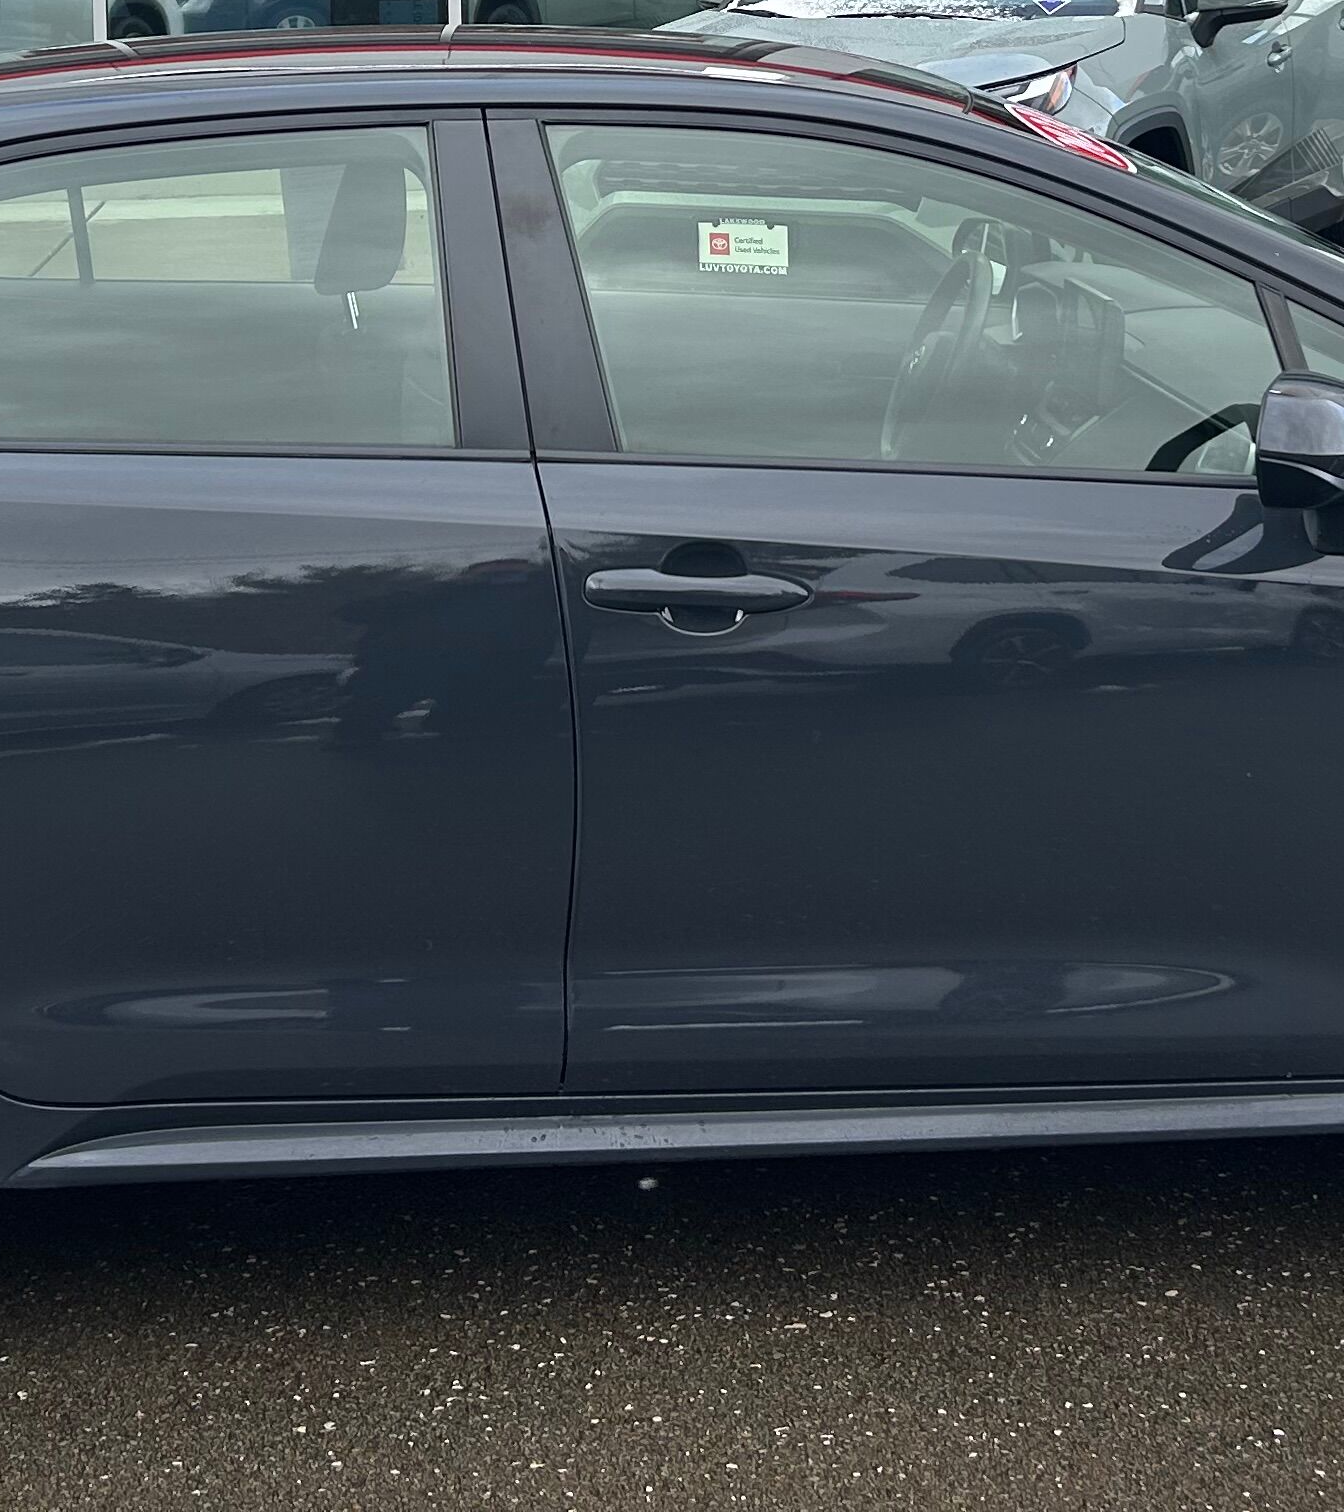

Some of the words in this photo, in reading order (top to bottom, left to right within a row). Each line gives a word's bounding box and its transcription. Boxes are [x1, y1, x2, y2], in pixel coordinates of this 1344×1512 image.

[734, 237, 764, 245] Certified
[734, 246, 752, 254] Used
[753, 246, 780, 255] Vehicles
[699, 262, 788, 276] LUVTOYOTA.COM
